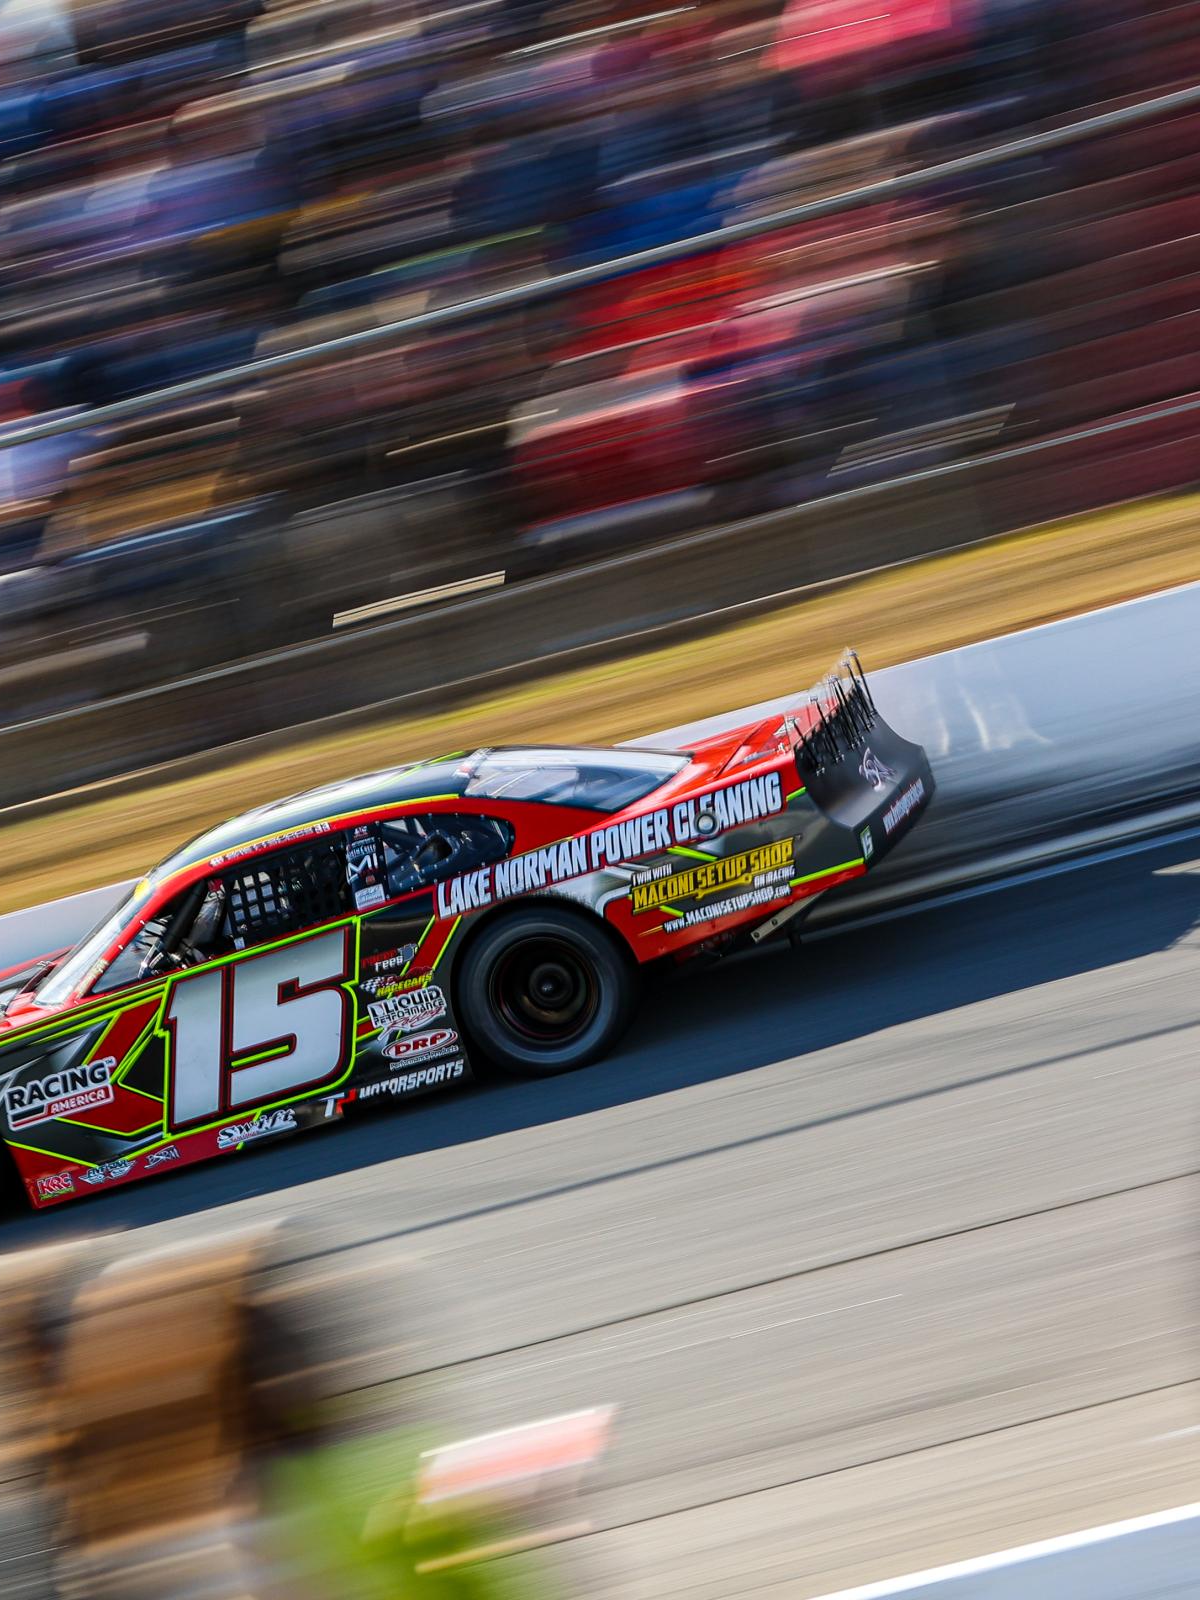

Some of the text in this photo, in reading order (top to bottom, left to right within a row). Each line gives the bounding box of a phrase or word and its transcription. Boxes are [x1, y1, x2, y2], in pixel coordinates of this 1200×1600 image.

[437, 866, 492, 919] LAKE
[494, 834, 587, 899] NORMAN
[590, 808, 672, 869] POWER
[633, 840, 793, 909] MACONI SETUP SHOP
[636, 869, 652, 885] WIN
[652, 863, 673, 880] WITH
[167, 927, 346, 1126] 15
[373, 999, 445, 1026] PERFORMANCE
[394, 1031, 448, 1056] DRP
[6, 1061, 110, 1112] RACING
[50, 1087, 106, 1115] AMERICA
[218, 1108, 296, 1141] Swift
